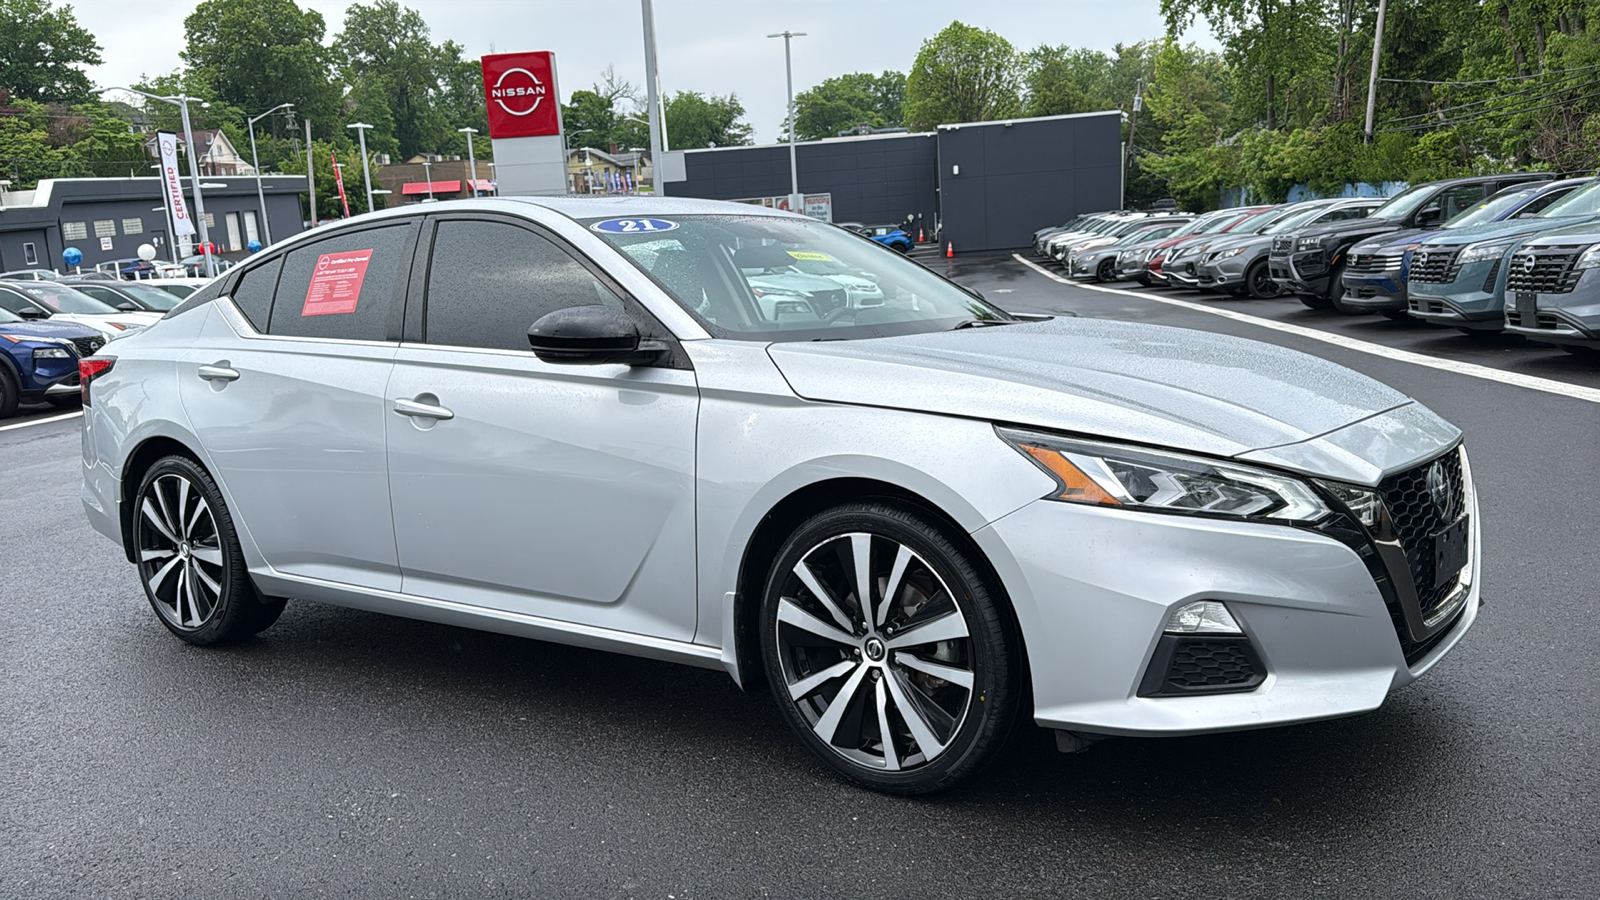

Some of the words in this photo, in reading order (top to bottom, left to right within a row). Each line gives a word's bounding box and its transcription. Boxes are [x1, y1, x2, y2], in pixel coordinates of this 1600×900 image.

[492, 86, 546, 98] NISSAN
[167, 167, 184, 219] CERTIFIED
[619, 220, 658, 231] 21
